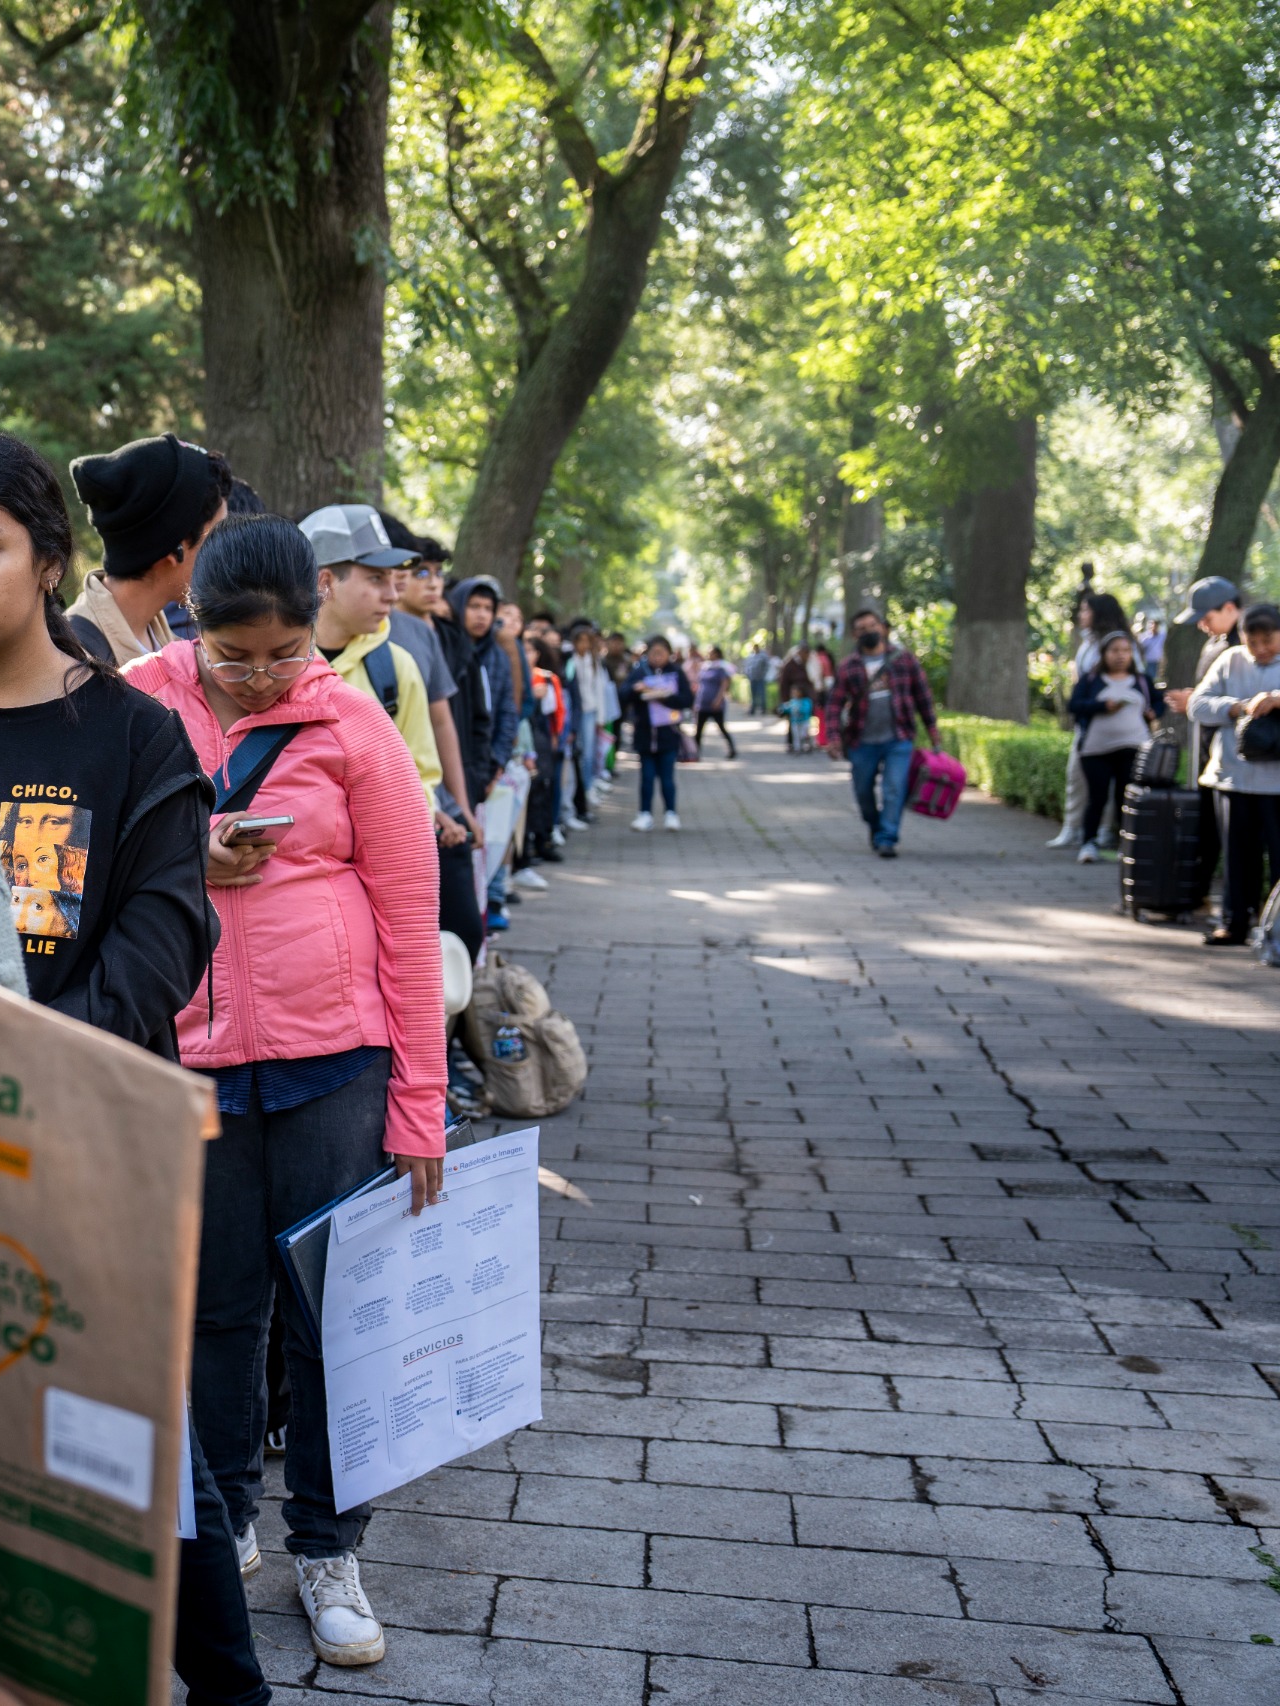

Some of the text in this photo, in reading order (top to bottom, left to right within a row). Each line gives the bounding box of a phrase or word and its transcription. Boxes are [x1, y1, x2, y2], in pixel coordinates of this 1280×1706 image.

[11, 784, 78, 801] CHICO,
[26, 939, 56, 955] LIE
[499, 1146, 524, 1157] Imagen
[402, 1333, 464, 1364] SERVICIOS
[404, 1369, 433, 1387] ESPECIALES
[342, 1398, 367, 1412] LOCALES
